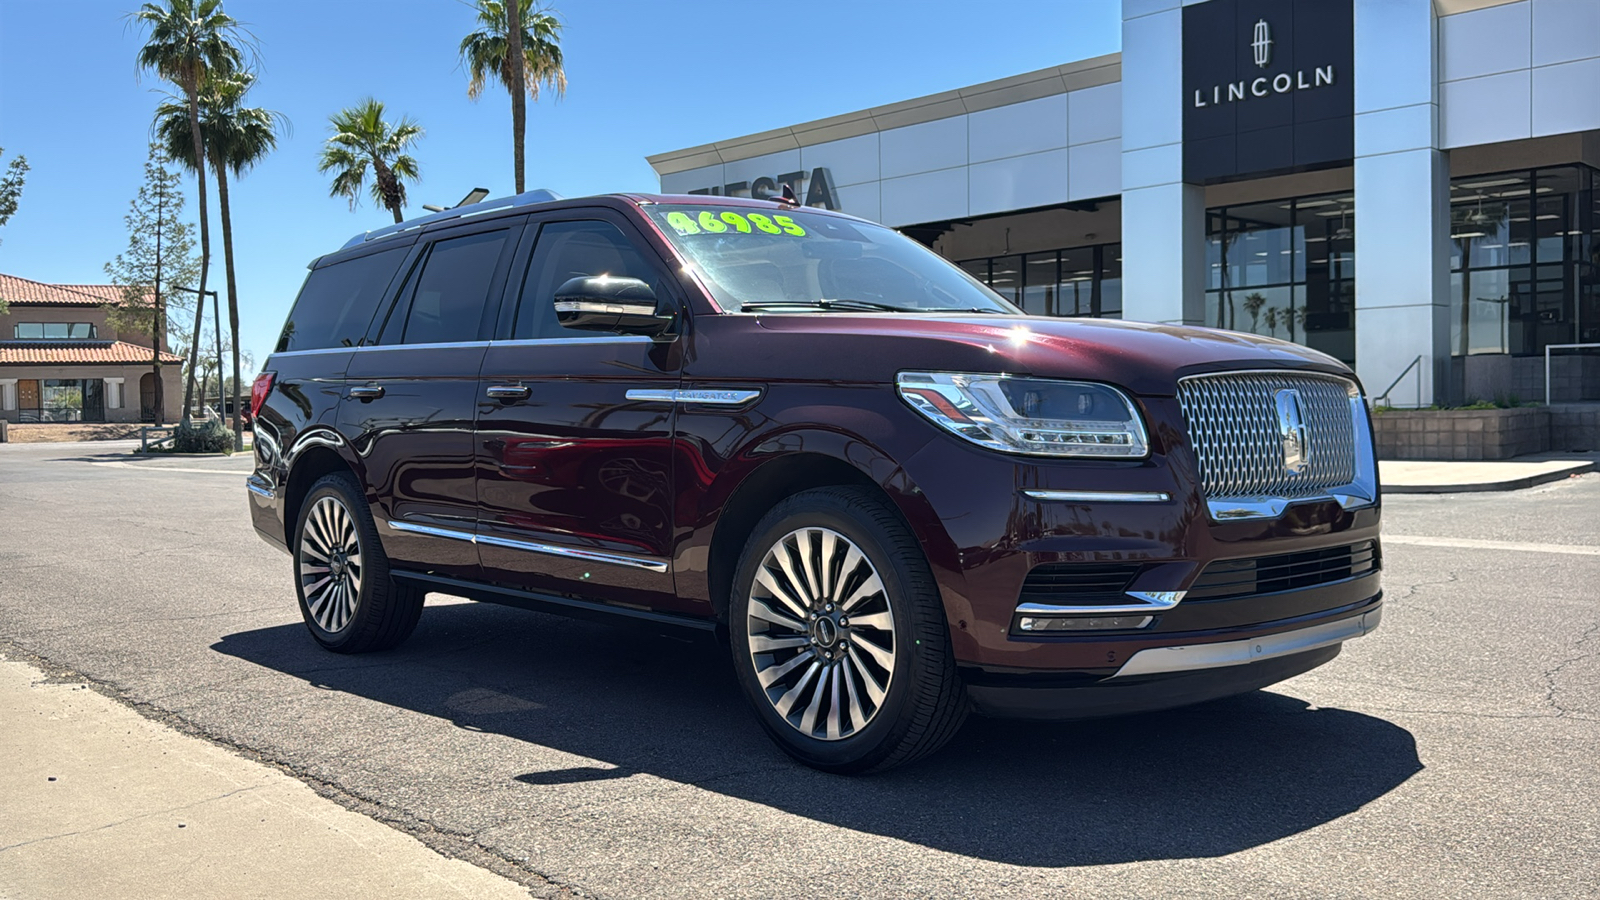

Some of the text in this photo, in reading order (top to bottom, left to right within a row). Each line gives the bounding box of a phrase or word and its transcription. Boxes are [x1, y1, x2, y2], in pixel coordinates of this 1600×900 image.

[1194, 65, 1333, 107] LINCOLN
[688, 167, 842, 209] STA
[667, 211, 806, 237] 46985
[677, 391, 737, 400] NAVIGATOR
